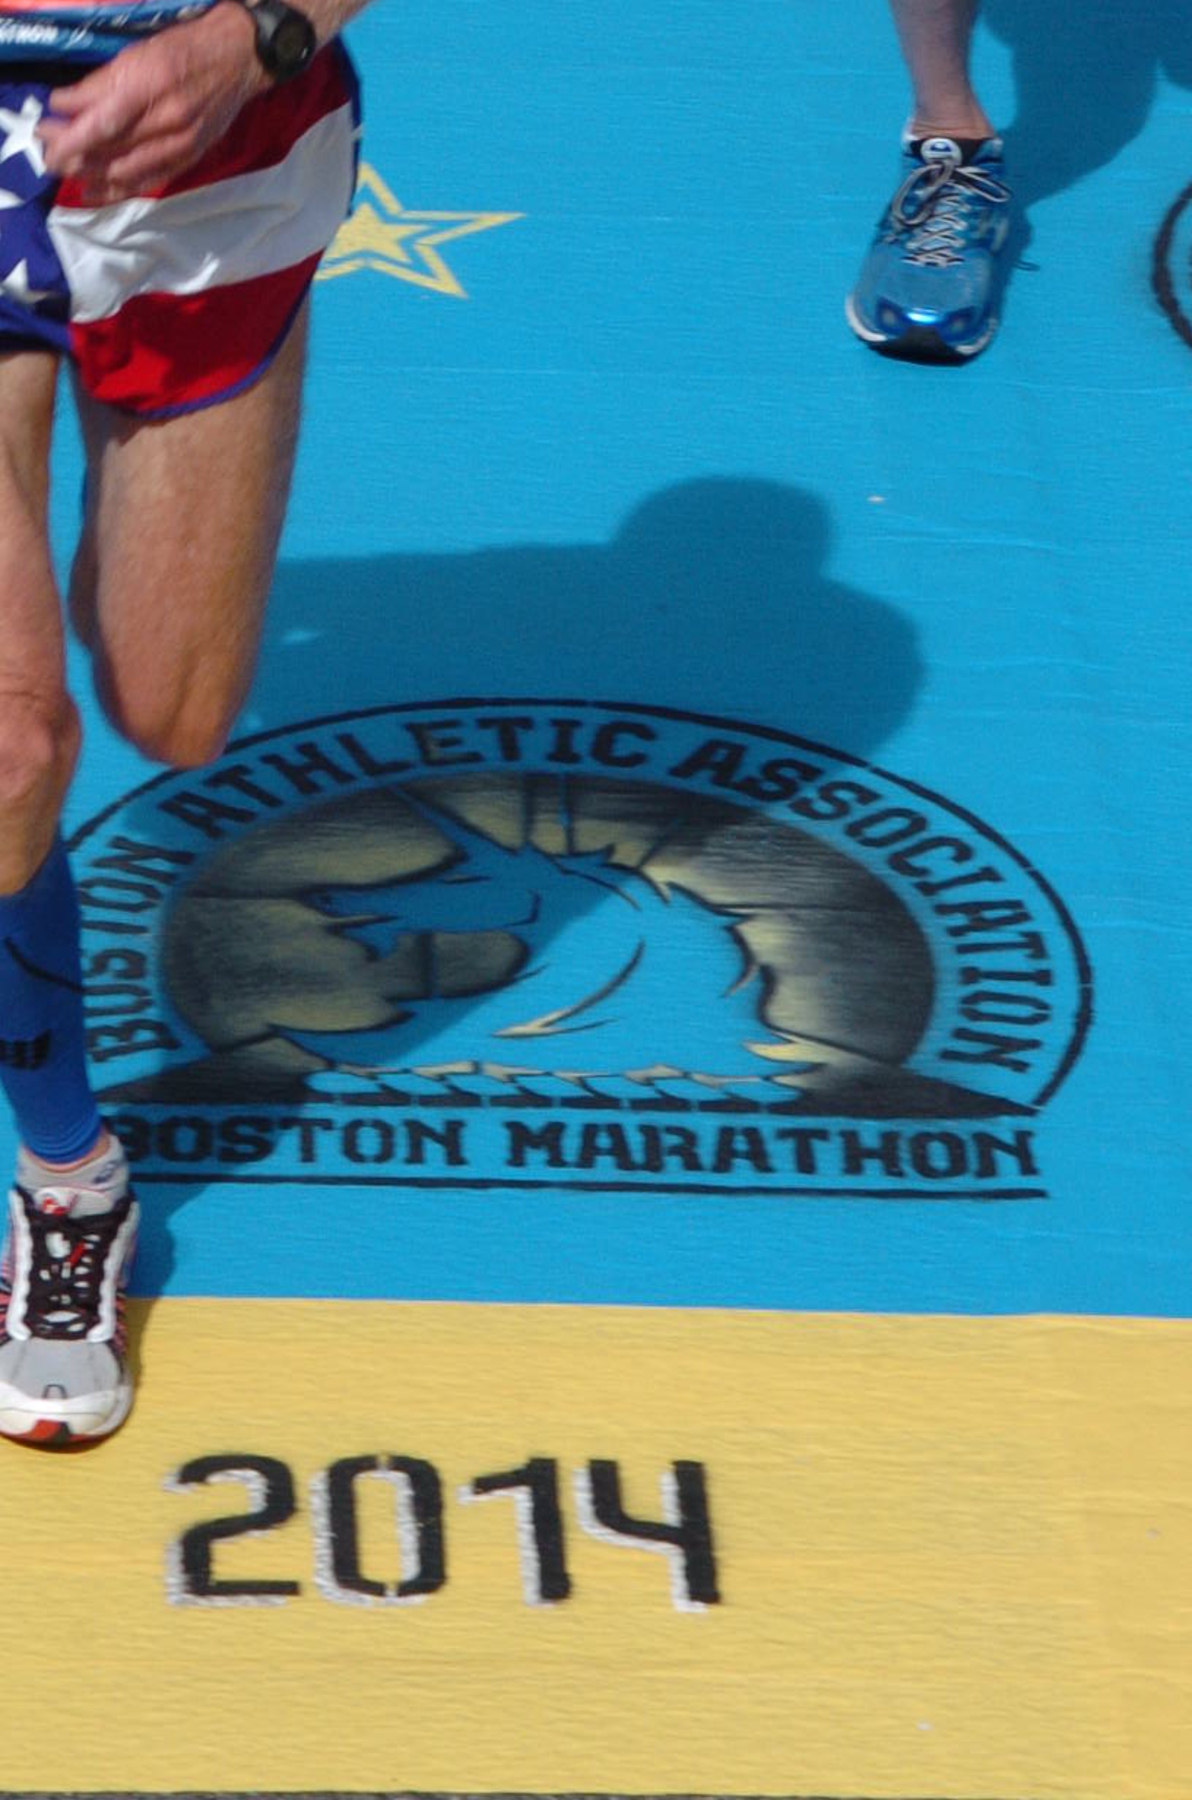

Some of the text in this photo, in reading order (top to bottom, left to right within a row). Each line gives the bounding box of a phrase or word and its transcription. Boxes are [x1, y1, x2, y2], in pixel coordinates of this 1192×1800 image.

[158, 715, 647, 837] ATHLETIC
[666, 734, 1054, 1074] ASSOCIATION
[111, 1113, 1038, 1179] BOSTON MARATHON
[166, 1455, 722, 1612] 2014
